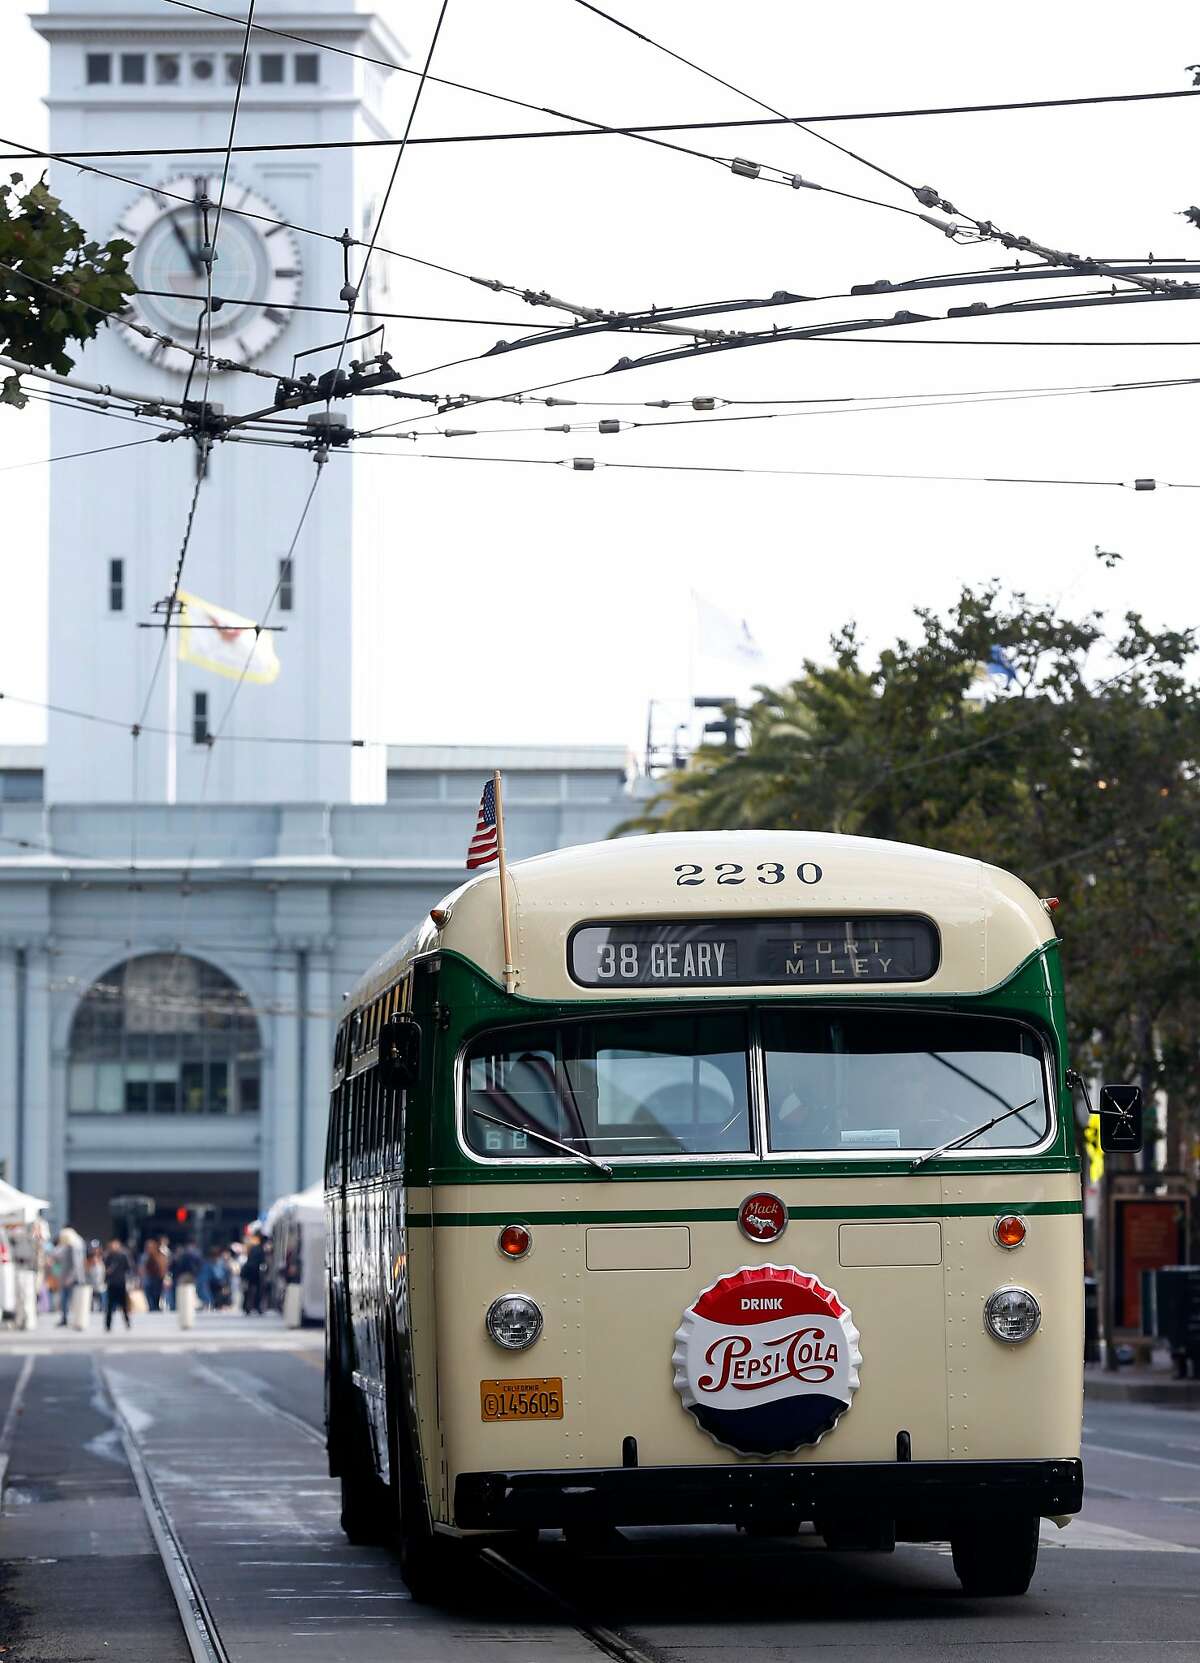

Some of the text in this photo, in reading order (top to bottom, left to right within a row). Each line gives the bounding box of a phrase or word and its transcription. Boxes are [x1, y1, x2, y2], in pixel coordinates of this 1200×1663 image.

[674, 863, 823, 886] 2230
[793, 940, 883, 955] FORT
[597, 943, 726, 978] 38 GEARY
[785, 958, 892, 975] MILEY
[744, 1202, 778, 1215] Mack
[740, 1298, 784, 1311] DRINK
